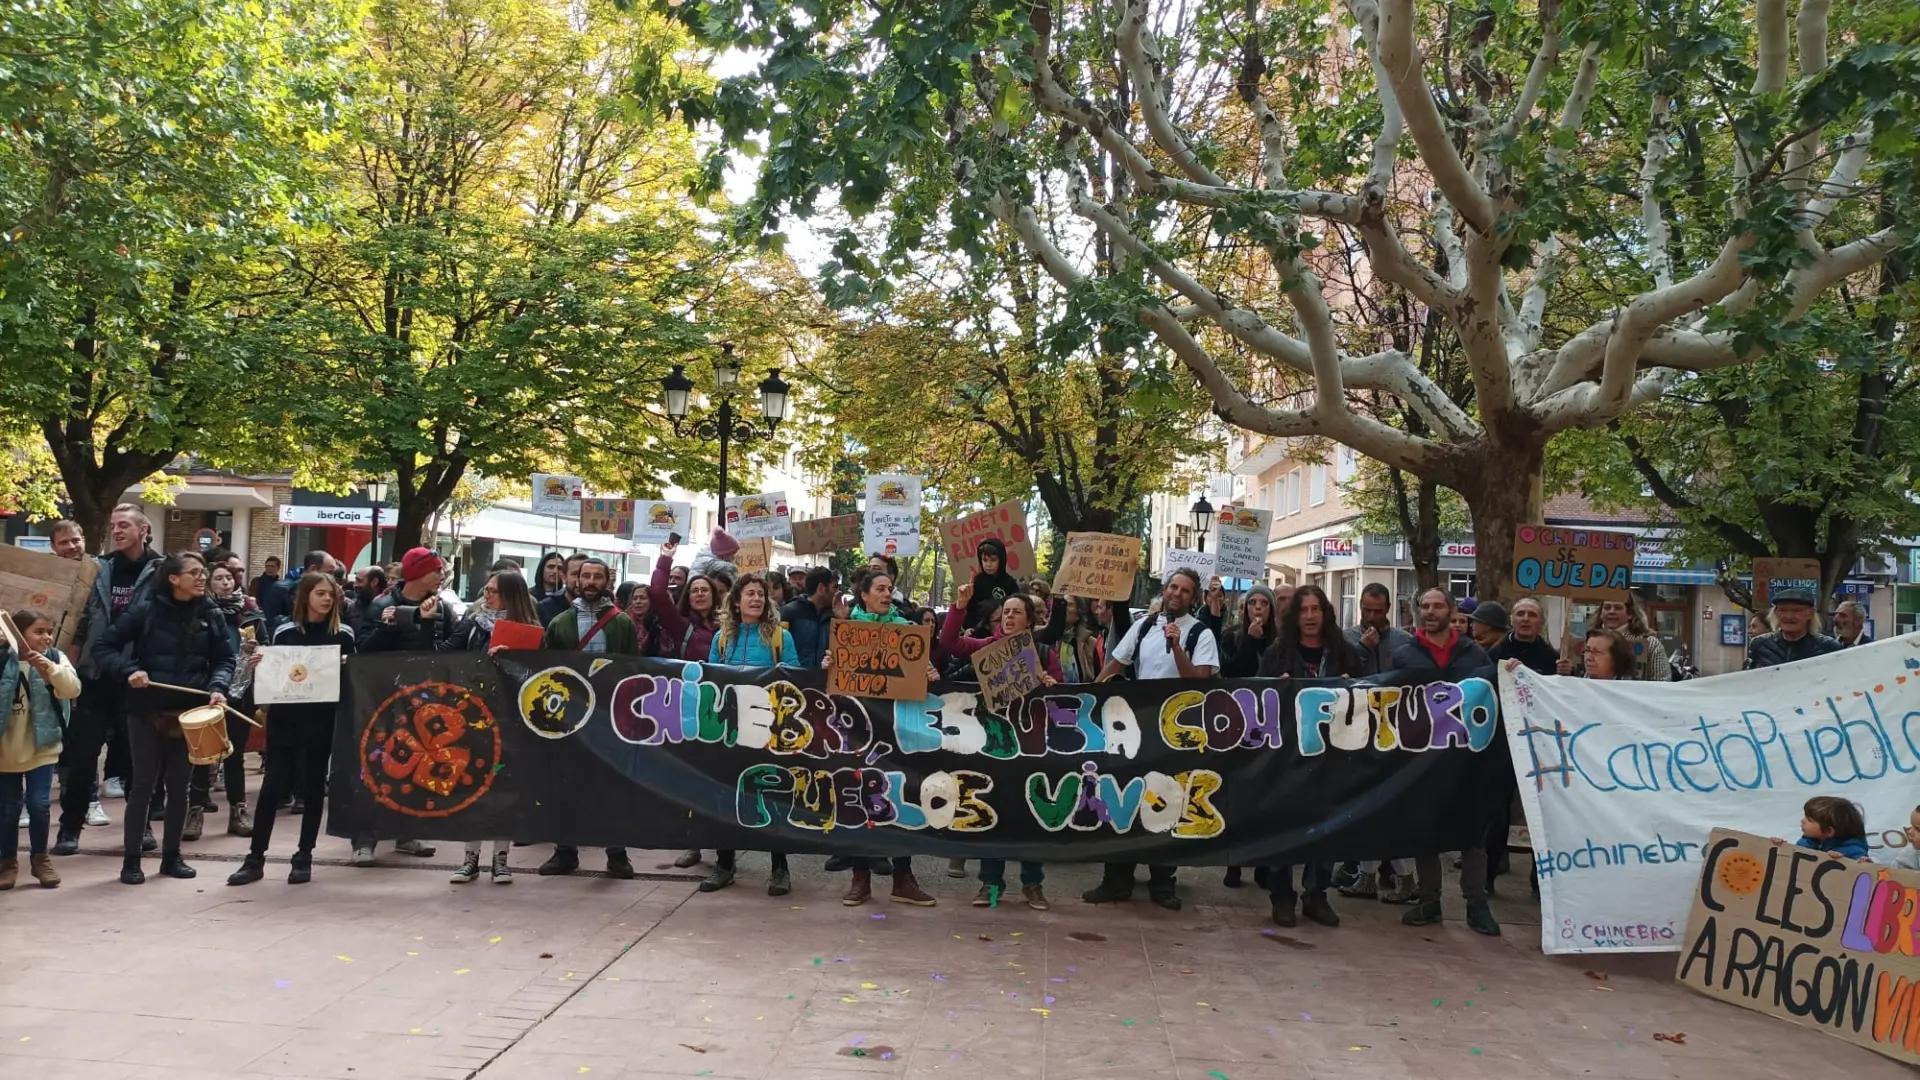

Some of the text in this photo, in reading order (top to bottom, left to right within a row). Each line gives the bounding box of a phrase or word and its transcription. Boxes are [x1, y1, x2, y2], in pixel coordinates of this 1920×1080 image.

[317, 510, 361, 522] iberCaja
[951, 508, 1009, 537] CANETO
[1104, 544, 1130, 557] AÑOS
[1168, 551, 1214, 566] SENTIDO
[1556, 547, 1576, 563] SE
[1085, 572, 1115, 586] COLE
[1516, 557, 1630, 591] QUEDA
[1770, 578, 1817, 589] SALVEMOS
[836, 623, 901, 649] Caneto
[836, 647, 900, 670] Pueblo
[1160, 687, 1283, 753] CON
[1296, 676, 1497, 757] FUTURO
[735, 764, 999, 832] PUEBLOS
